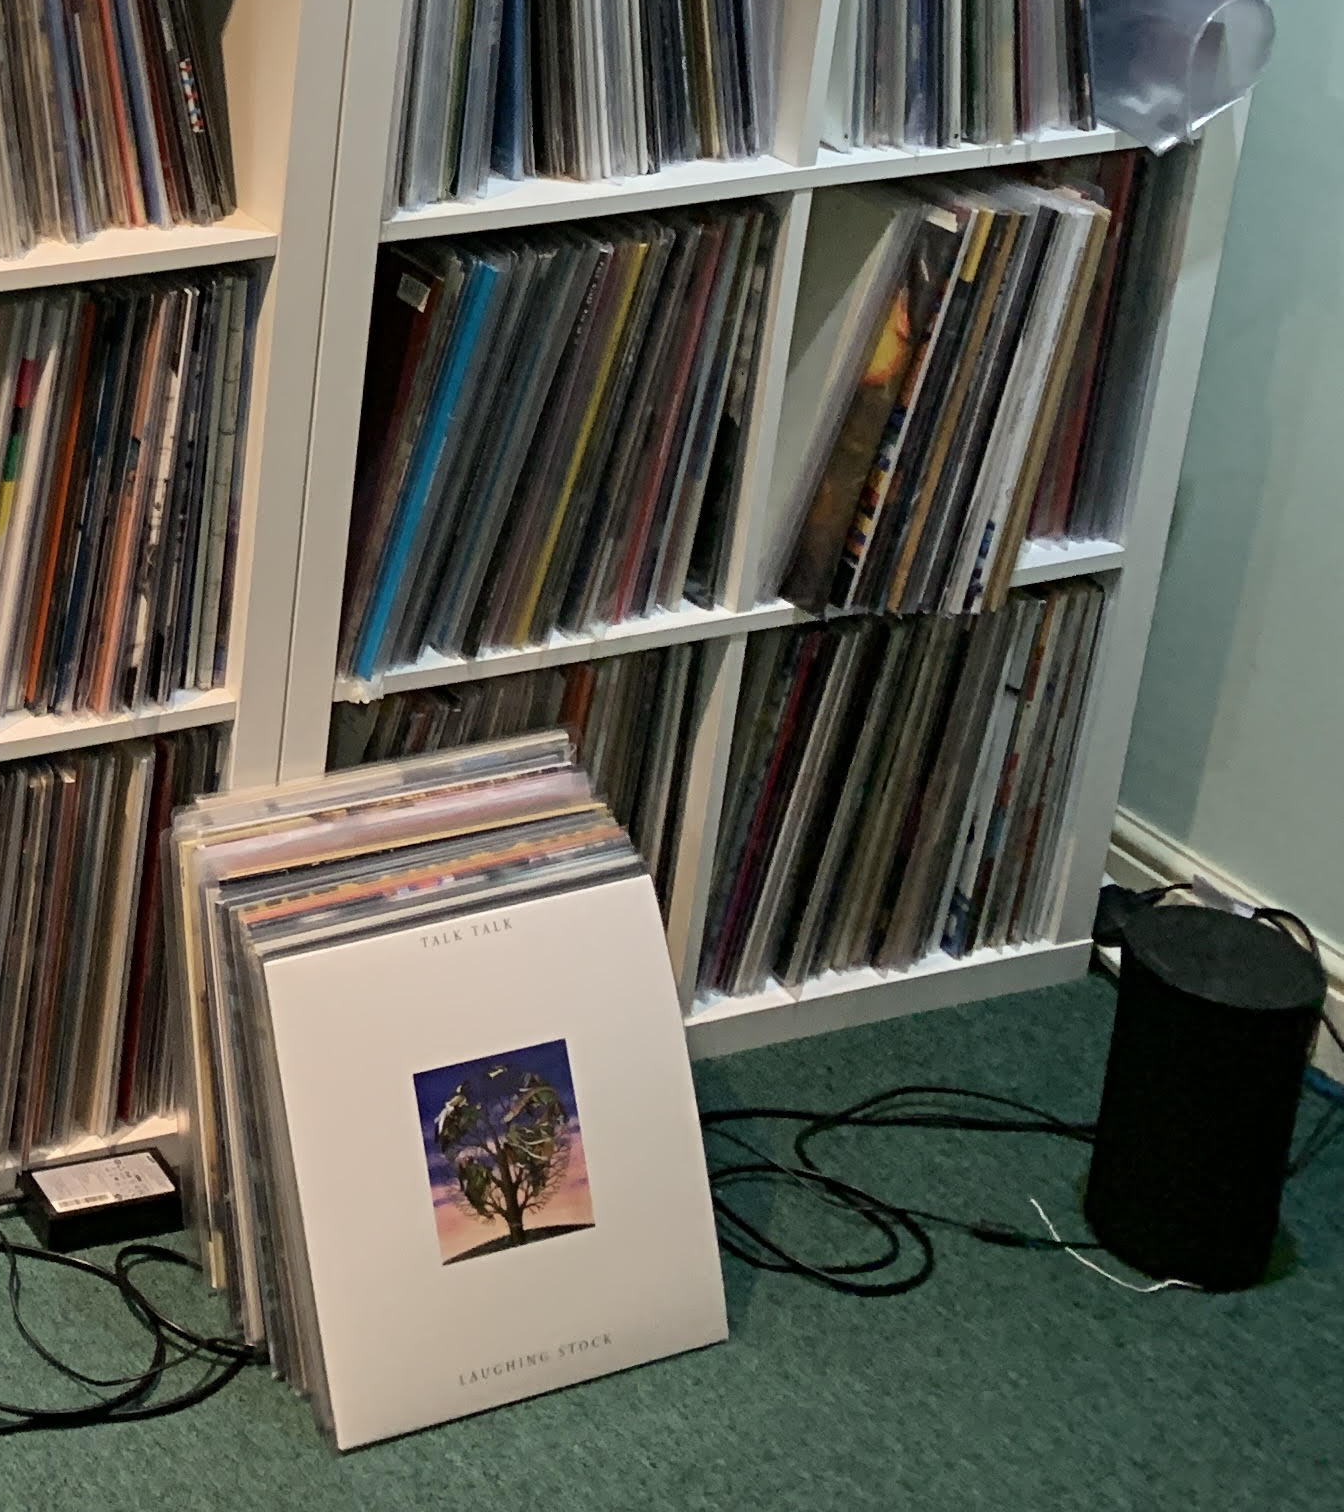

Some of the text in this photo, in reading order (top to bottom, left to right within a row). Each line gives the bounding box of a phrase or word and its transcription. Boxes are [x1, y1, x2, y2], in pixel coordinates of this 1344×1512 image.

[420, 918, 513, 948] TALK TALK
[459, 1333, 612, 1386] LAUGHING STOCK
